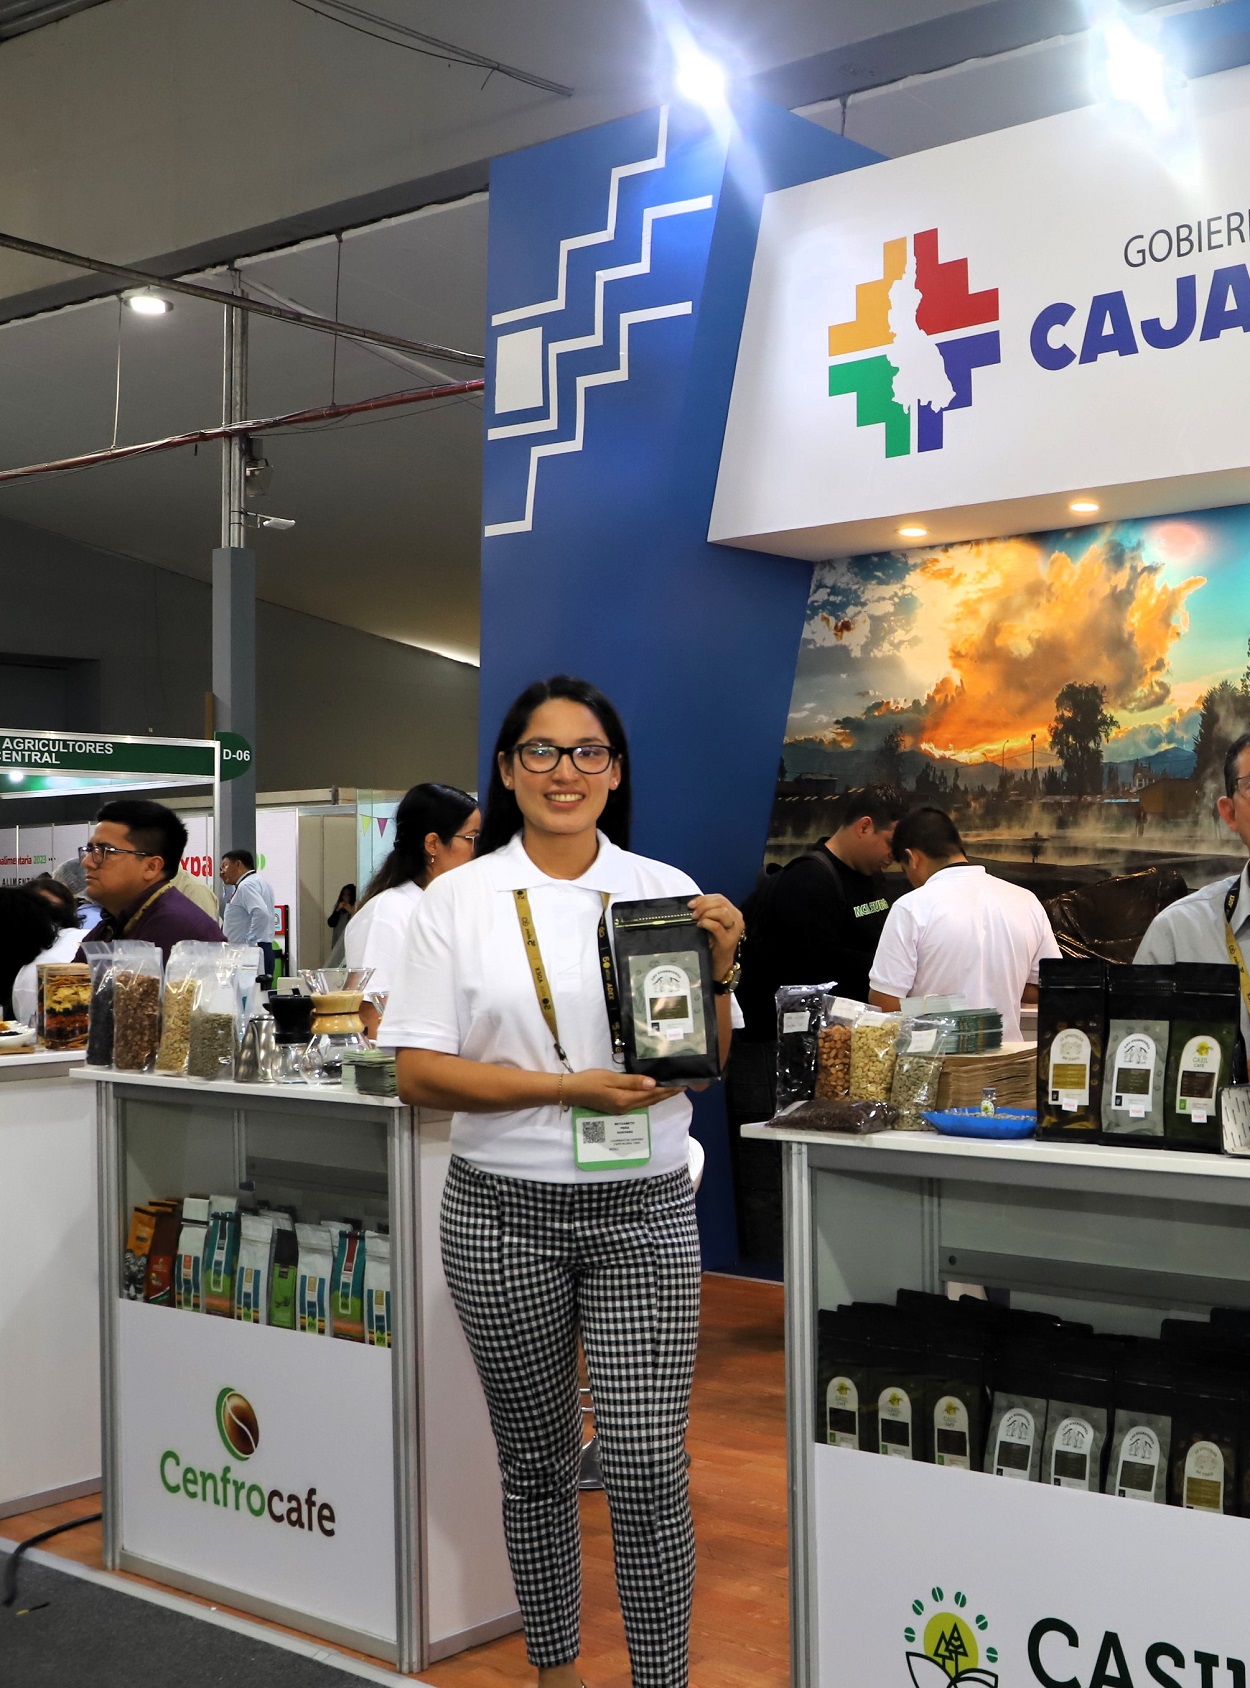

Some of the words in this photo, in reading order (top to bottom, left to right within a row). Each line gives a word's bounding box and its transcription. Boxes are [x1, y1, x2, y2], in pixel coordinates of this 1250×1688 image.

[2, 738, 114, 755] AGRICULTORES
[222, 749, 251, 762] D-06
[33, 855, 47, 865] 2023
[606, 983, 615, 1000] ADEX
[160, 1449, 336, 1538] Cenfrocafe
